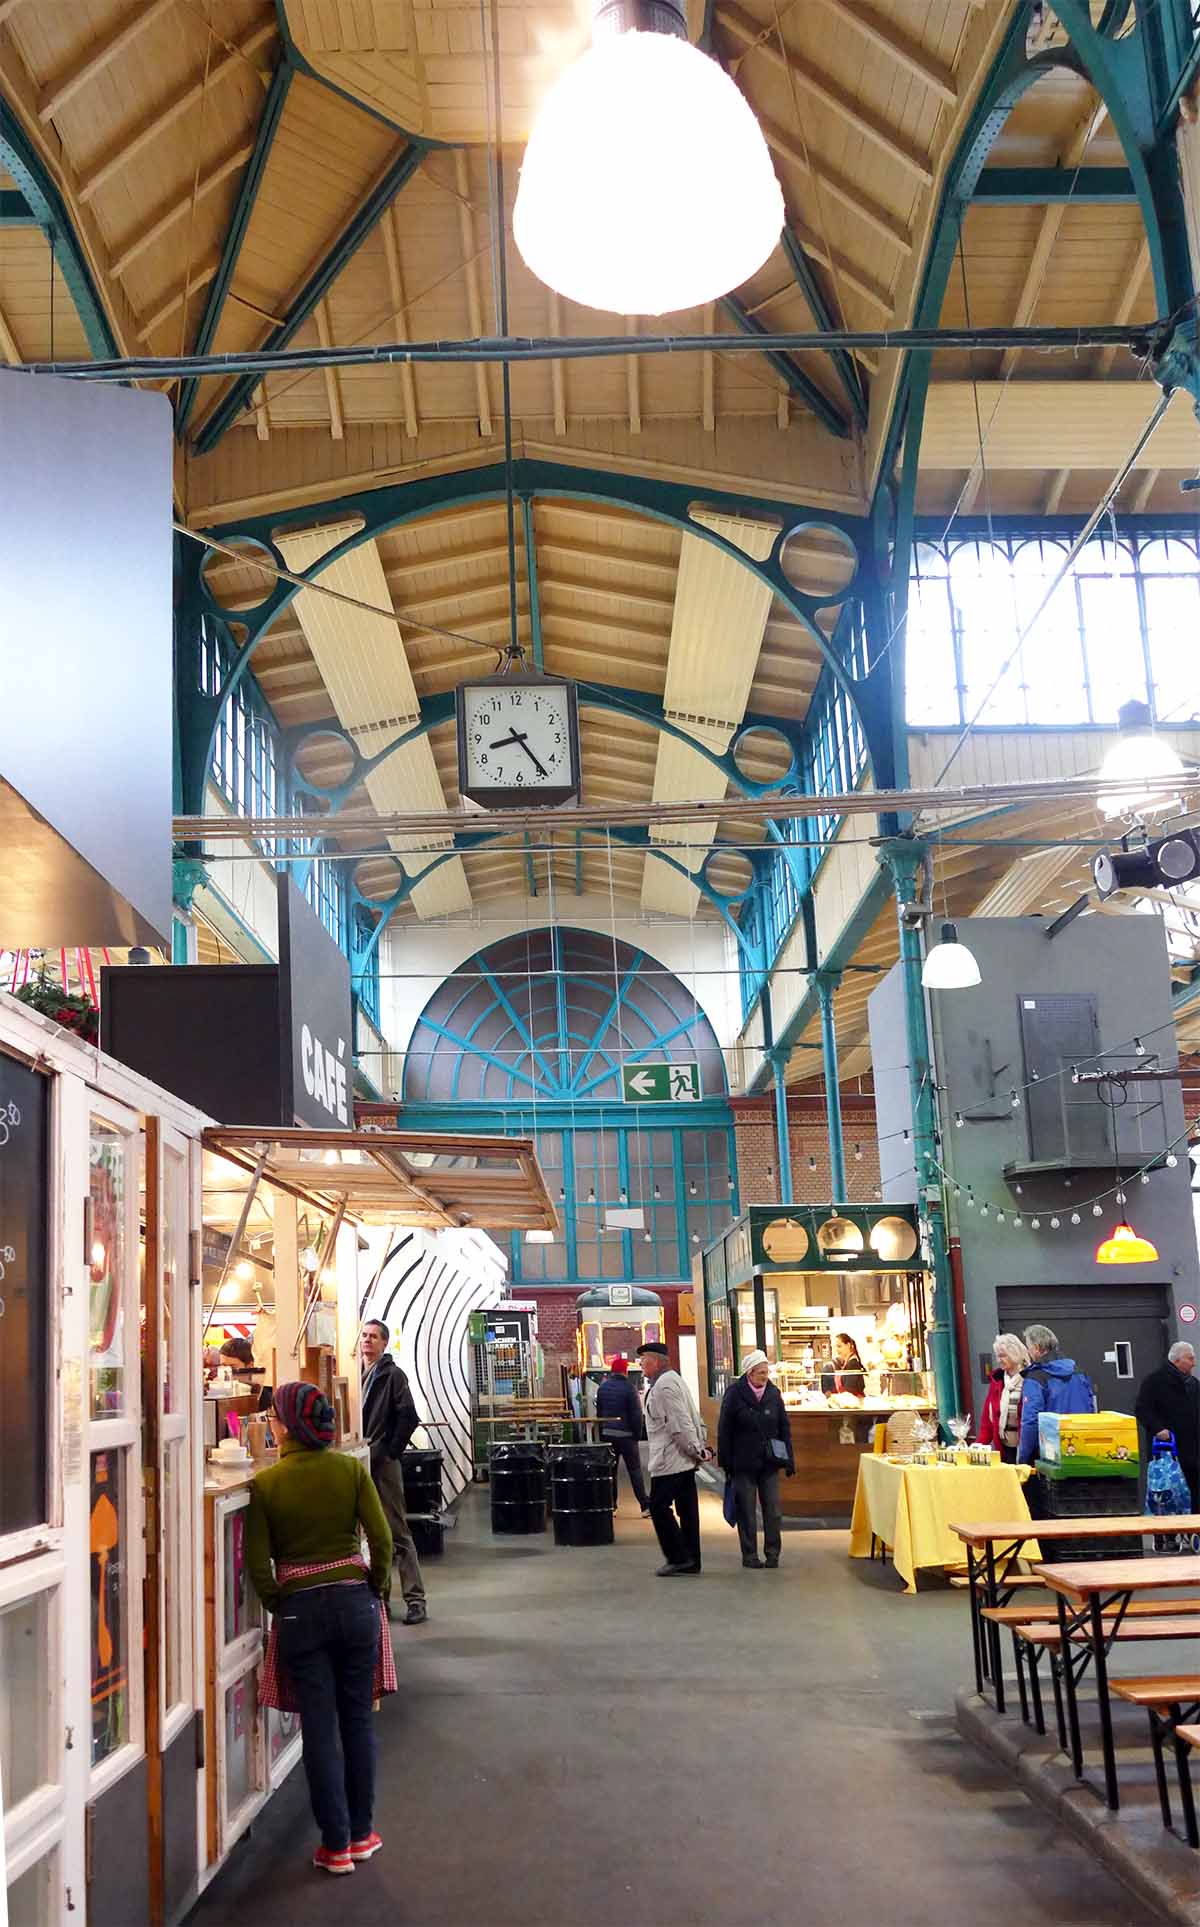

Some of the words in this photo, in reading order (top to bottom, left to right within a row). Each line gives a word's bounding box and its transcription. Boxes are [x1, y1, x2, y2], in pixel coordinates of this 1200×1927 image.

[510, 695, 522, 706] 12
[492, 701, 502, 712] 11
[534, 702, 539, 712] 1
[480, 714, 490, 725] 10
[548, 714, 555, 725] 2
[475, 734, 482, 744] 9
[554, 733, 561, 744] 3
[481, 753, 488, 764] 8
[548, 754, 556, 763] 4
[497, 767, 504, 778] 7
[516, 772, 524, 782] 6
[535, 767, 543, 777] 5
[301, 1023, 348, 1126] CAFÉ
